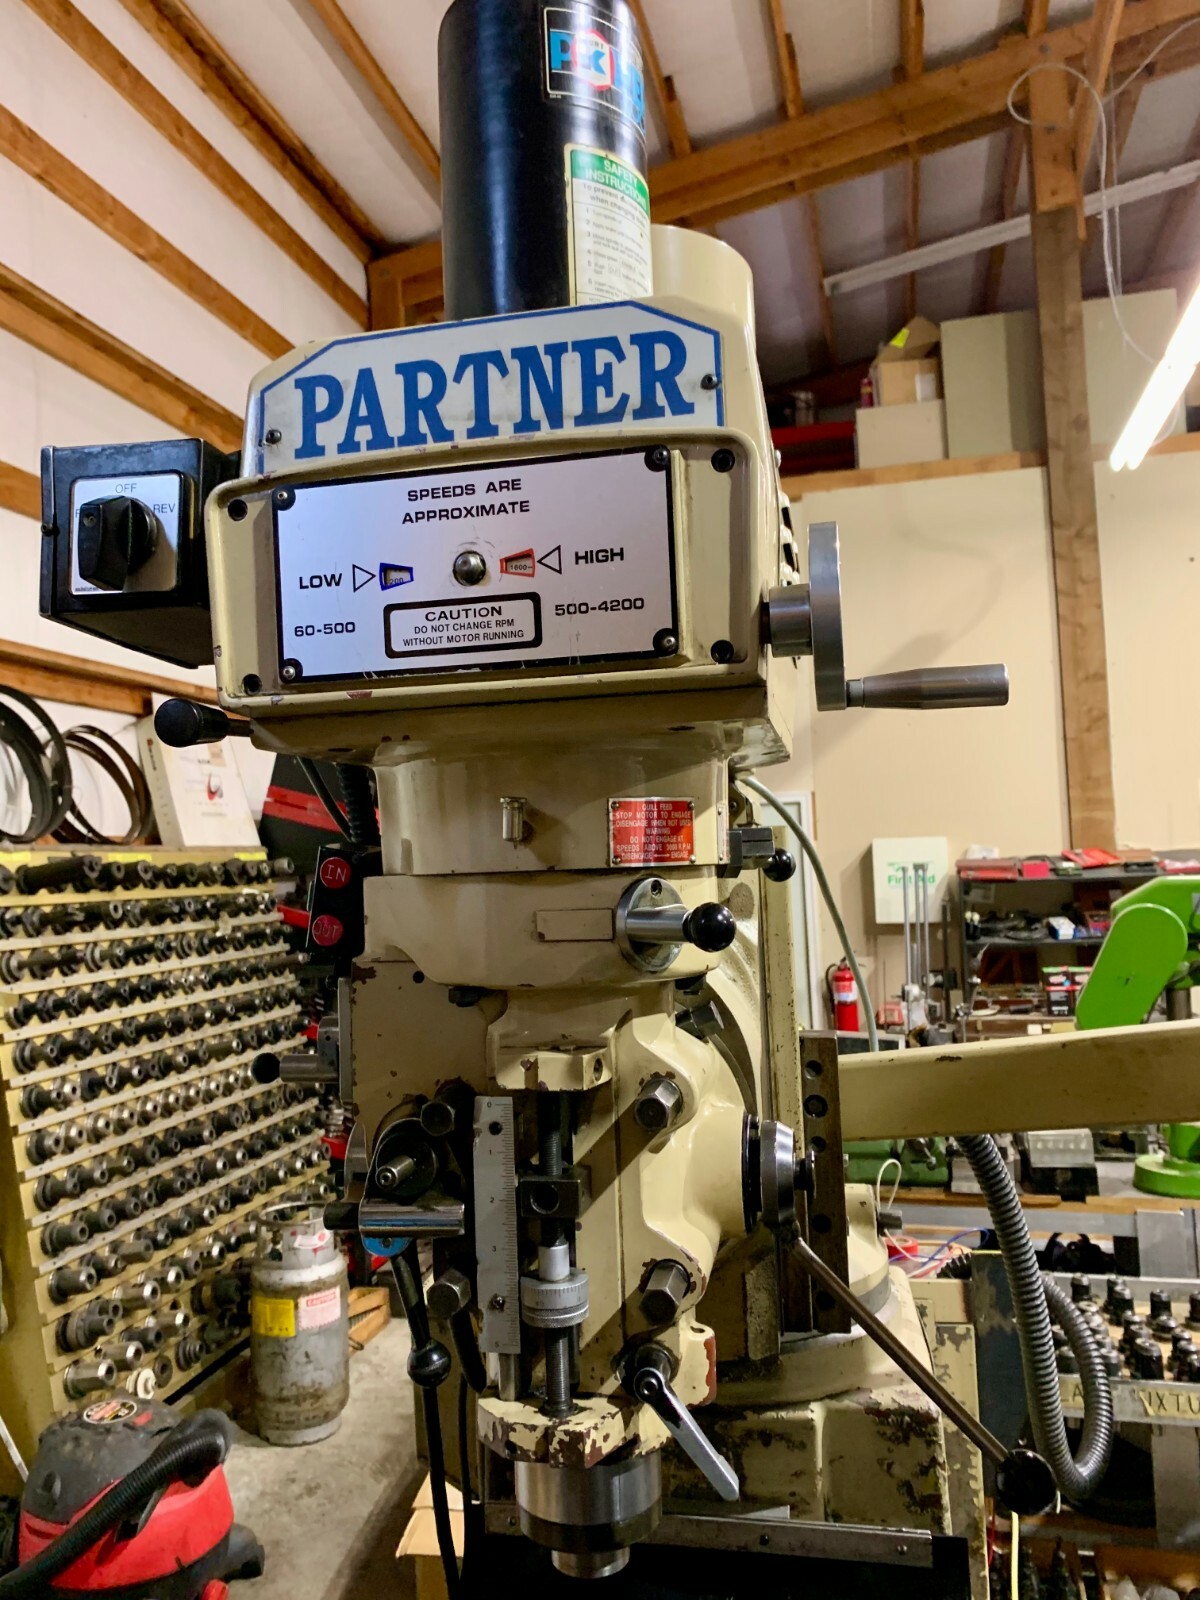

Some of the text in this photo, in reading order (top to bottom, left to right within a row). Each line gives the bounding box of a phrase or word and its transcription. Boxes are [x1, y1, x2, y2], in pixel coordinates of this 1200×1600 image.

[604, 160, 637, 188] SAFETY
[294, 329, 694, 459] PARTNER
[115, 483, 137, 493] OFF
[408, 479, 522, 501] SPEEDS ARE
[153, 503, 175, 514] REV
[402, 500, 530, 524] APPROXIMATE
[575, 547, 624, 564] HIGH
[299, 573, 342, 589] LOW
[425, 606, 502, 621] CAUTION
[555, 598, 644, 616] 500-4200
[294, 622, 355, 637] 60-500
[414, 619, 514, 634] DO NOT CHANGE RPM
[403, 630, 524, 646] WITHOUT MOTOR RUNNING
[325, 864, 346, 882] IN
[314, 921, 339, 938] OUT
